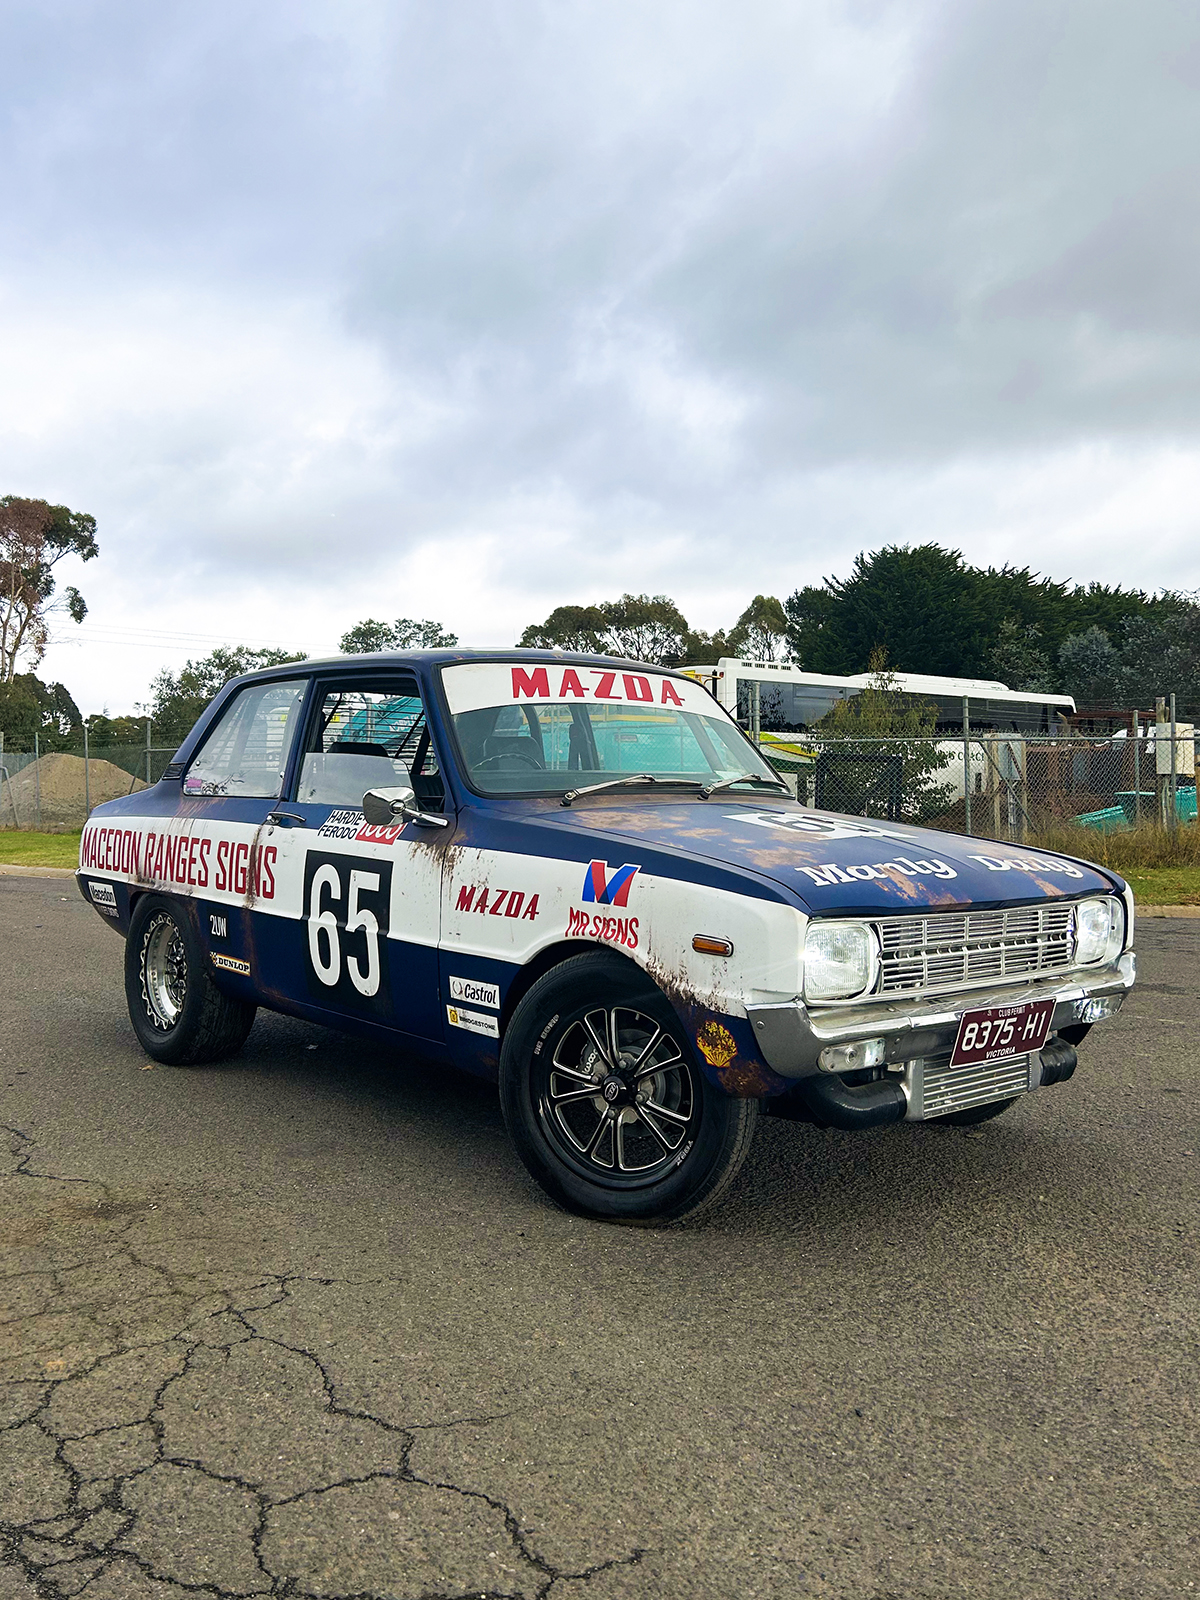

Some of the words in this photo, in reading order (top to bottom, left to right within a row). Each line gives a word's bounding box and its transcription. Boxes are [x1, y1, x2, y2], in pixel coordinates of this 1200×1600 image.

[511, 667, 685, 706] MAZDA
[317, 825, 357, 839] FERODO
[81, 827, 142, 875] MACEDON
[143, 833, 211, 888] RANGES
[216, 841, 278, 899] SIGNS
[795, 857, 958, 887] Manly
[967, 855, 1083, 879] Daily
[455, 886, 540, 921] MAZDA
[210, 915, 226, 937] 2UW
[308, 864, 380, 996] 65
[565, 906, 590, 937] MR
[589, 915, 639, 949] SIGNS
[218, 957, 250, 971] DUNLOP
[465, 984, 496, 1004] Castrol
[459, 1015, 496, 1030] BRIDGESTONE
[999, 1008, 1010, 1017] CLUB
[1011, 1006, 1025, 1015] PERMIT
[986, 1046, 1015, 1059] VICTORIA
